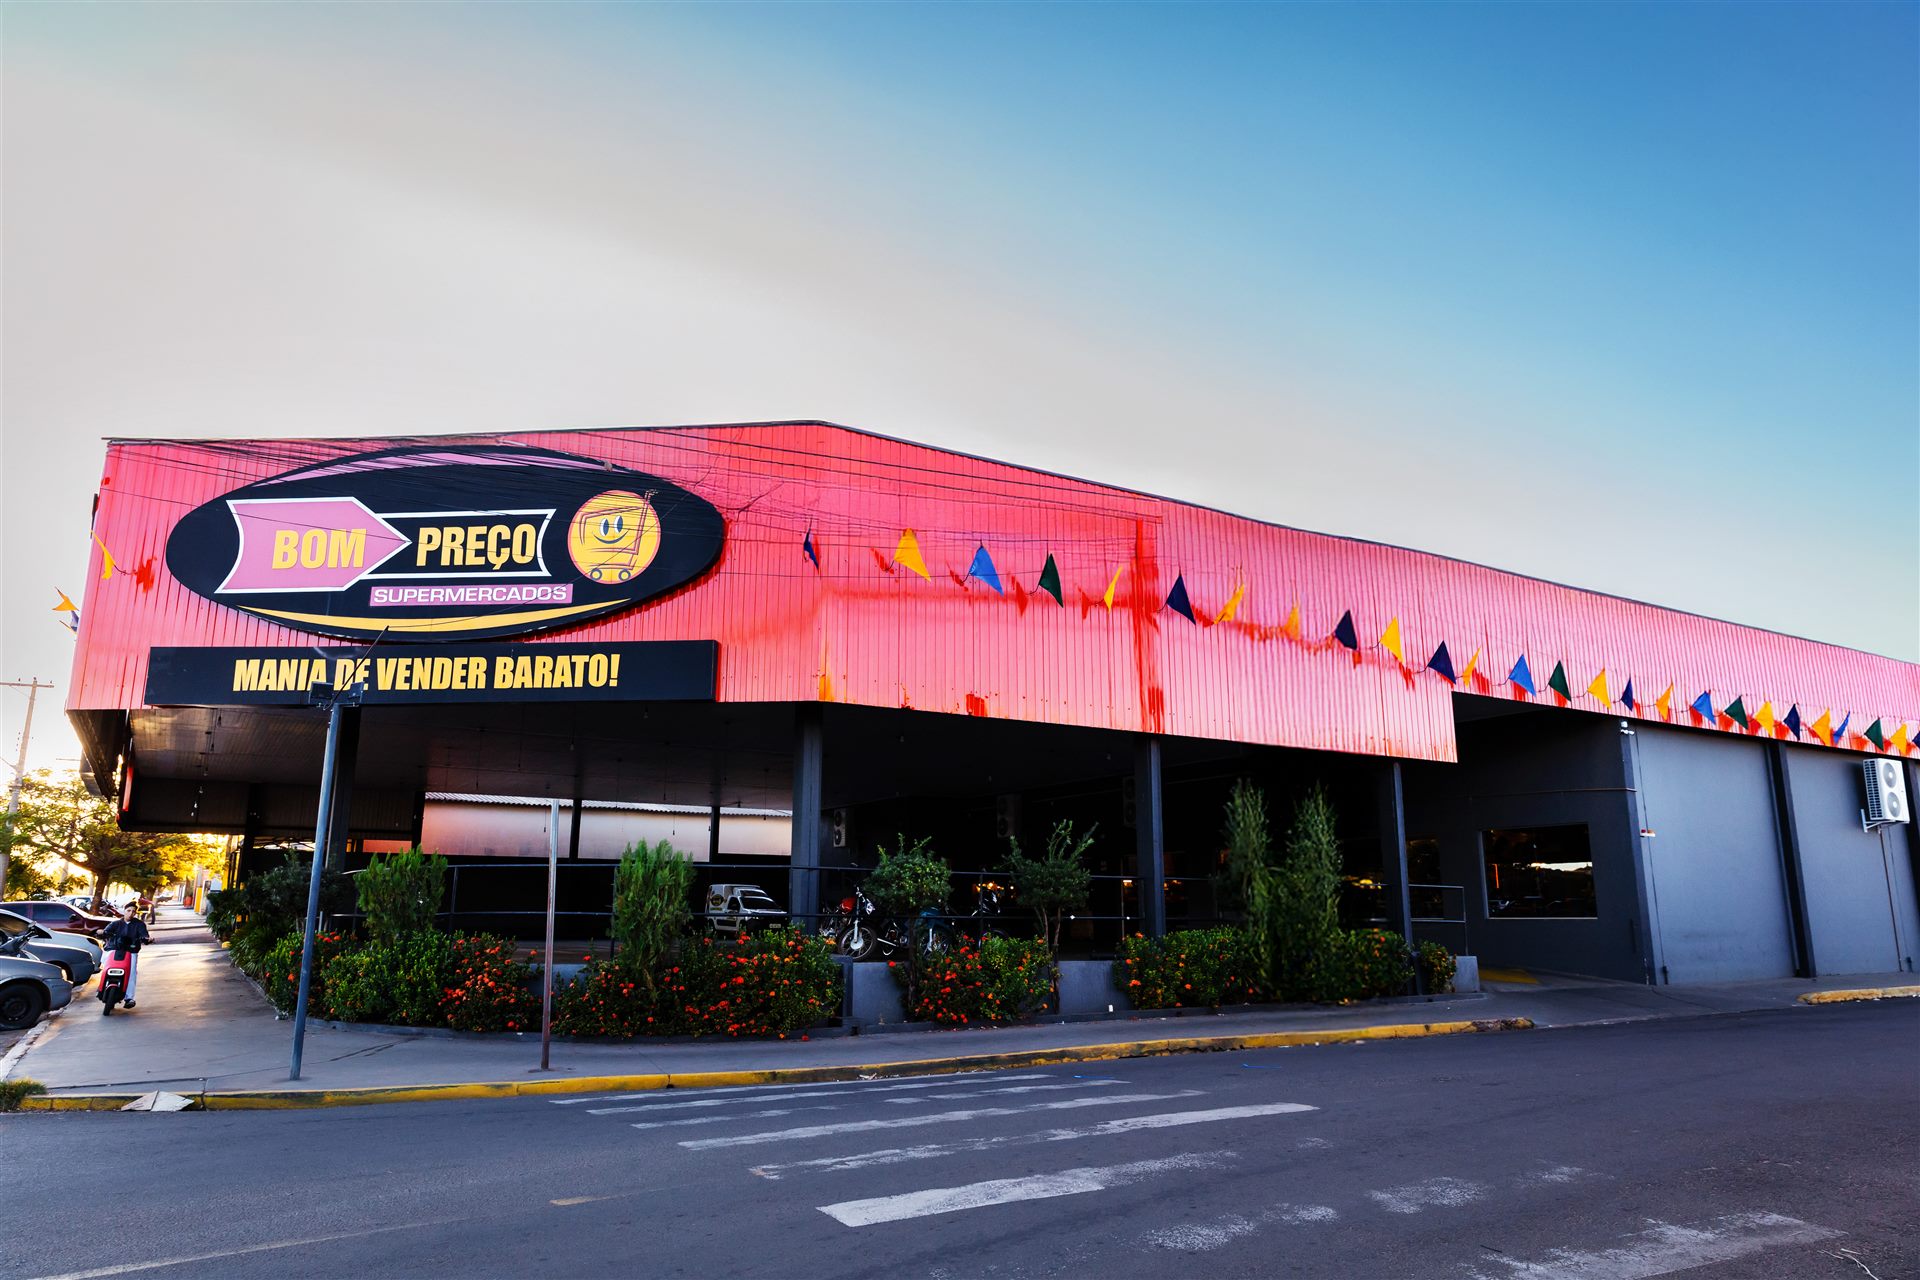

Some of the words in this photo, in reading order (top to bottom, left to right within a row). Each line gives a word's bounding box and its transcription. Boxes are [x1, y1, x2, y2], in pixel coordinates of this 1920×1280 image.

[272, 528, 367, 570] BOM
[416, 523, 537, 571] PREÇO
[373, 584, 568, 605] SUPERMERCADOS
[232, 658, 327, 691] MANIA
[333, 658, 371, 691] DE
[376, 656, 488, 691] VENDER
[493, 653, 621, 689] BARATO!
